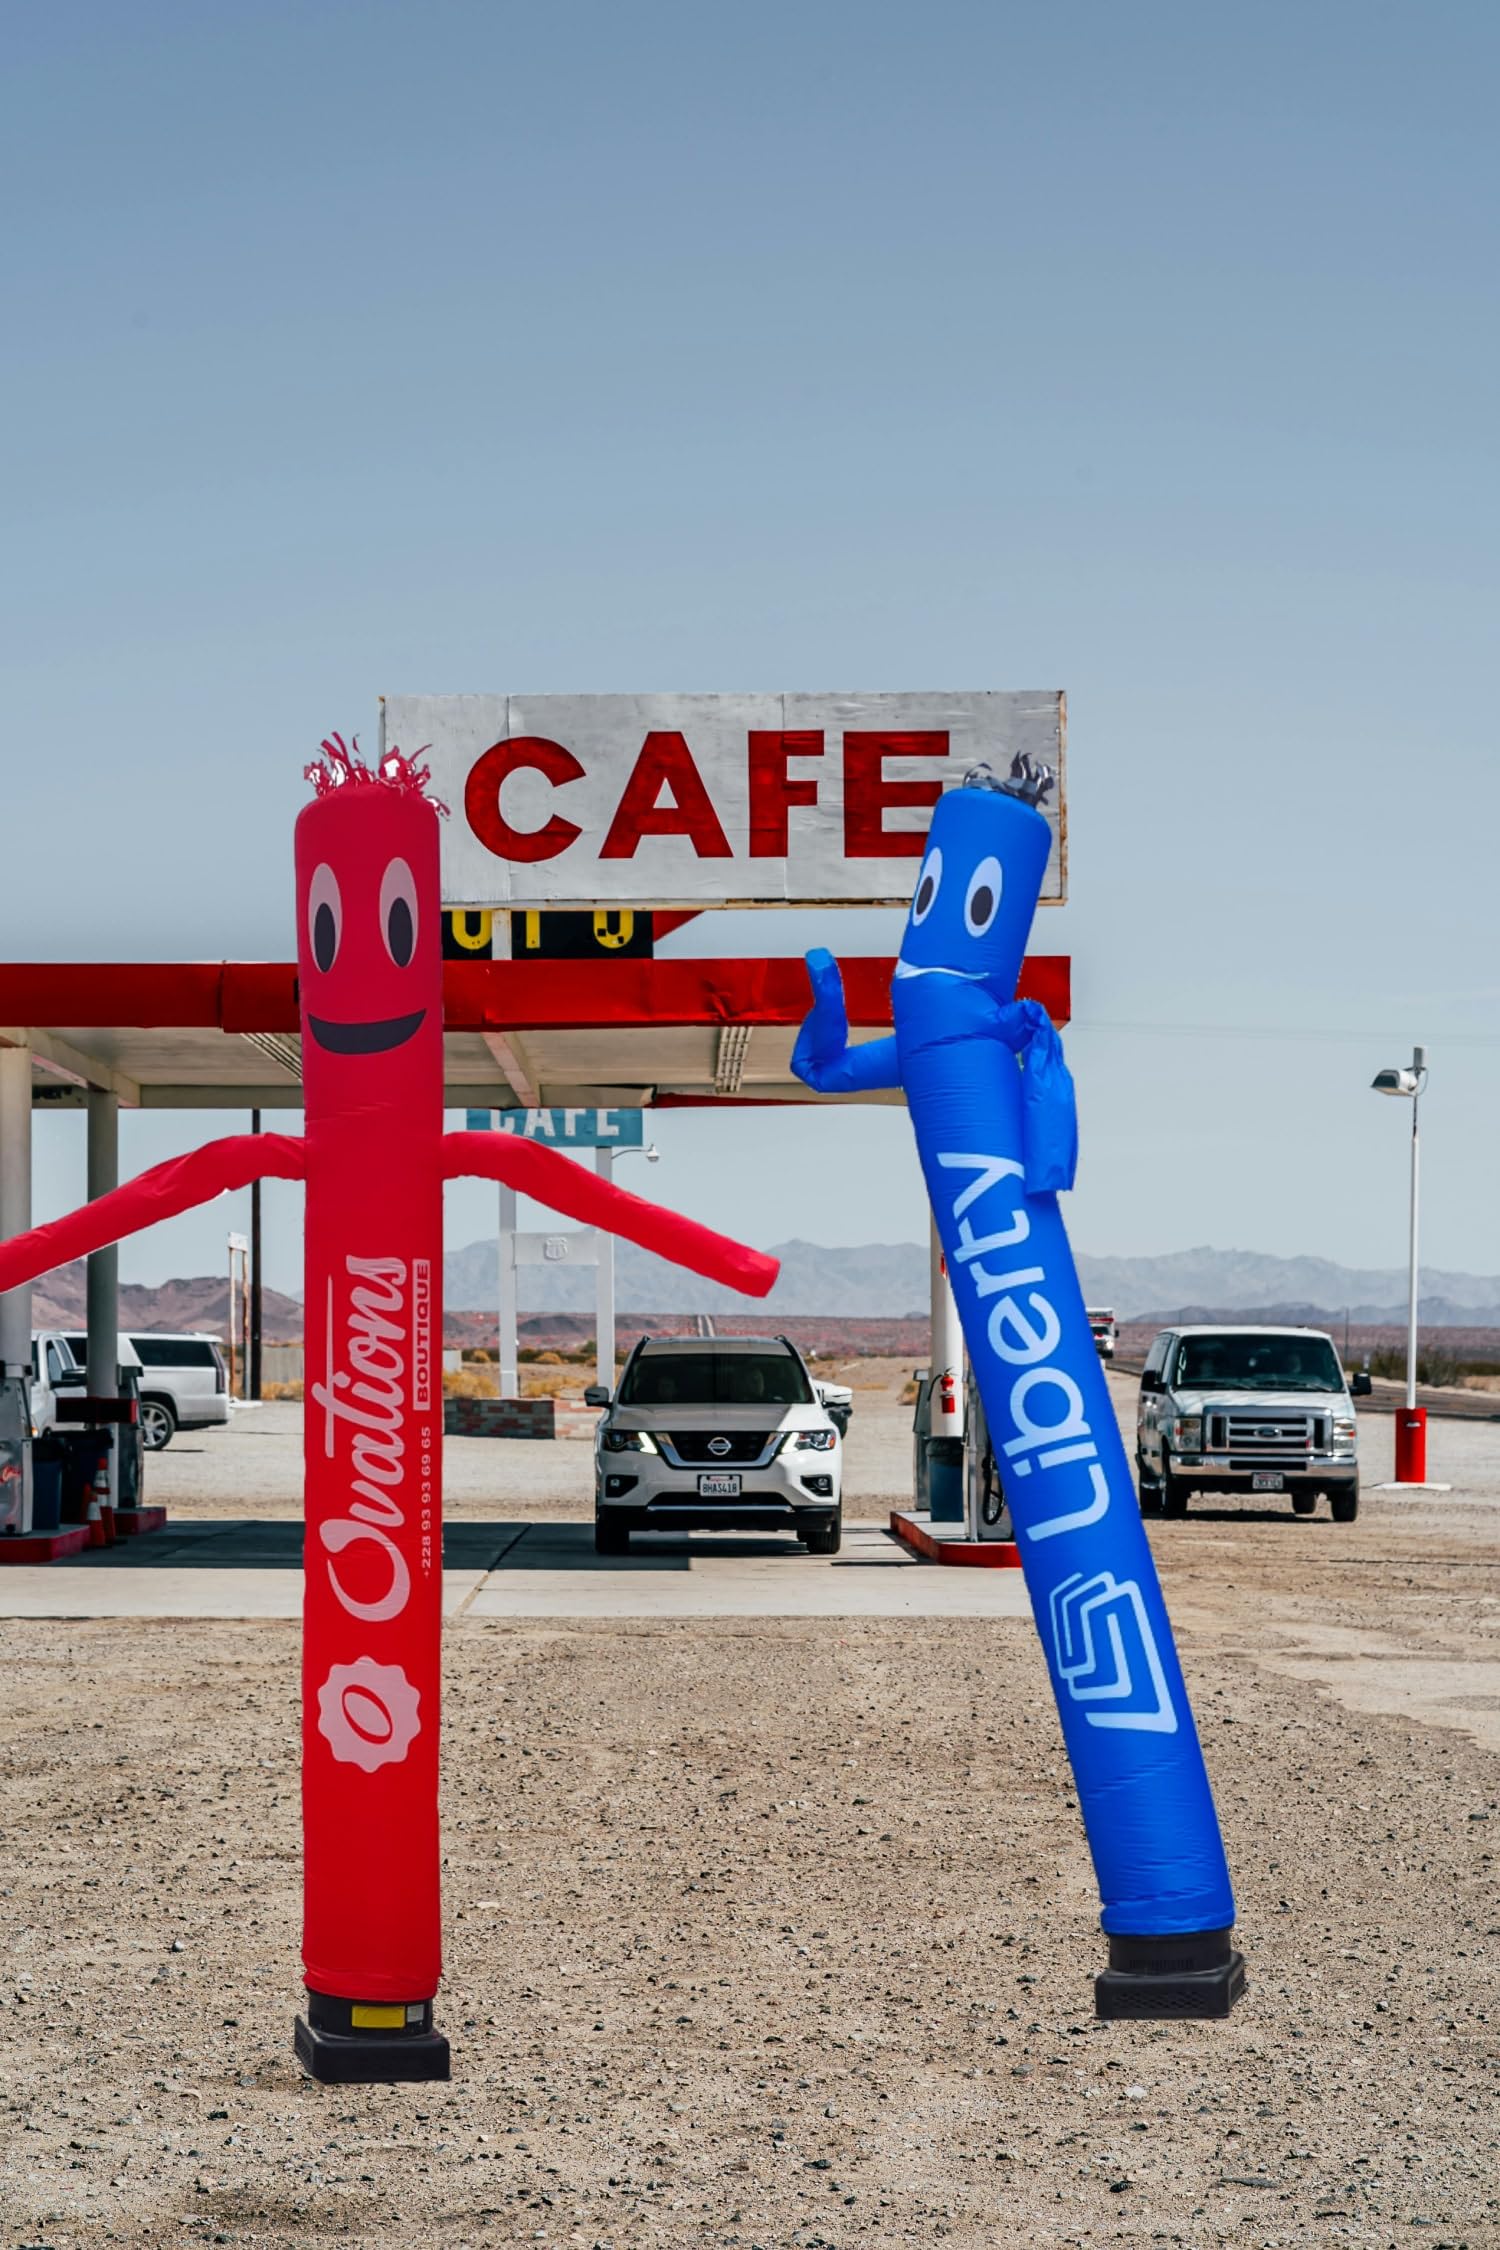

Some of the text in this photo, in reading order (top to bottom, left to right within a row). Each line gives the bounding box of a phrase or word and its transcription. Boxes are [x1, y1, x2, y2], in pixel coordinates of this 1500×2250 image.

[464, 730, 950, 863] CAFE
[417, 1263, 428, 1402] BOUTIQUE
[938, 1153, 1110, 1541] Liberty
[312, 1255, 410, 1622] Ovations
[421, 1426, 431, 1578] +228 93 93 69 65
